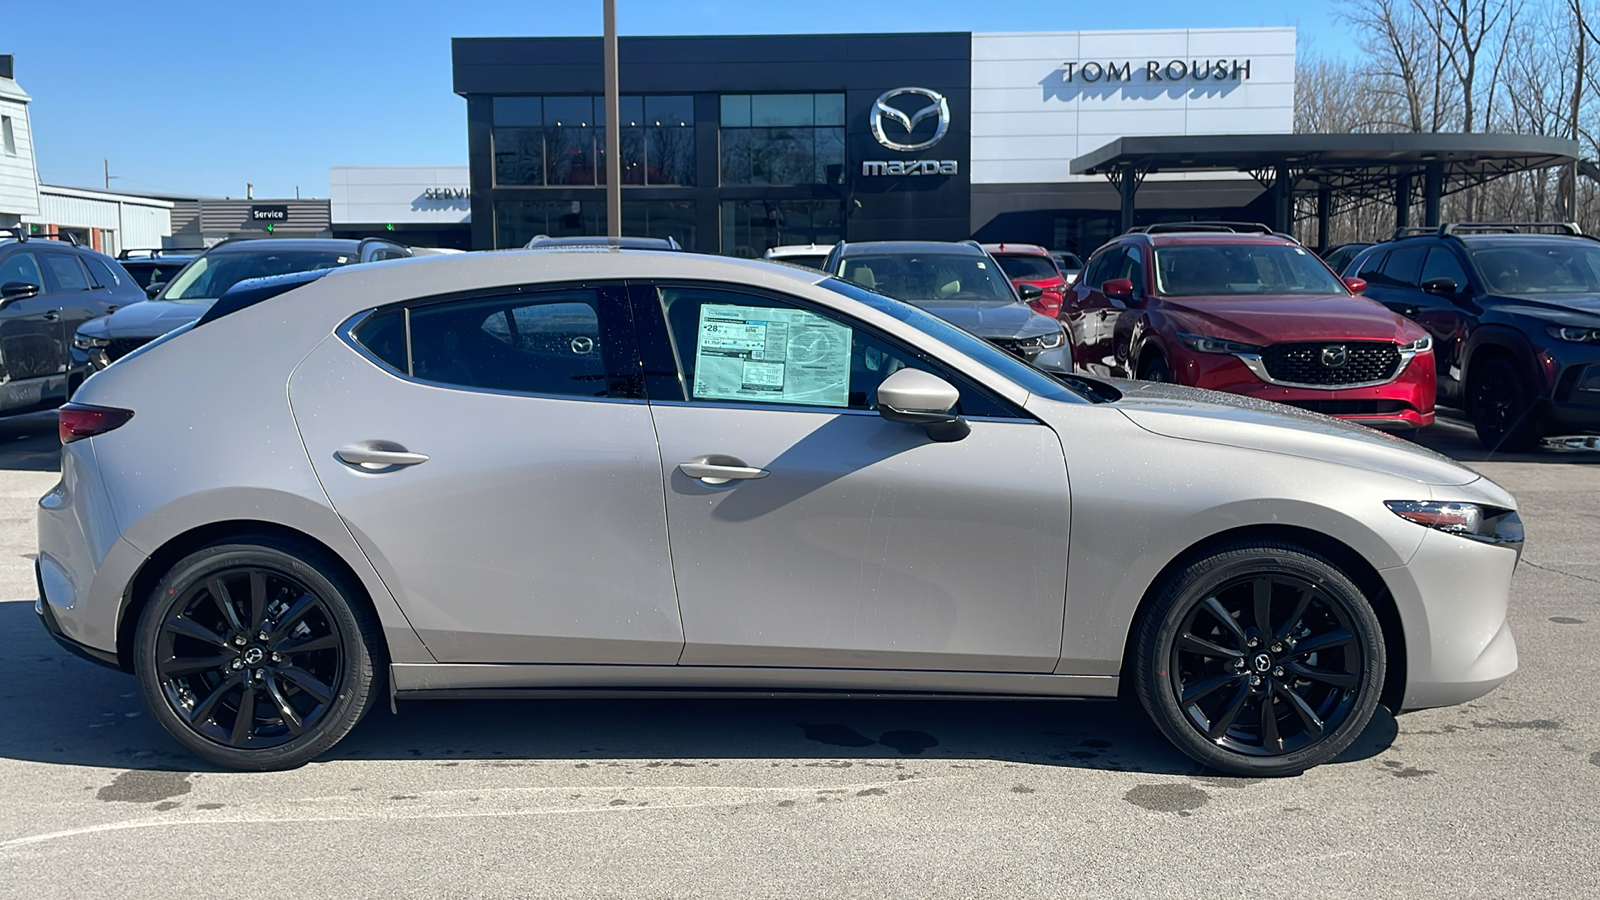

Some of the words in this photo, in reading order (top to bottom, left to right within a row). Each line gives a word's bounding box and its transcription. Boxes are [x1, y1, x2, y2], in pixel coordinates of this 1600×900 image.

[1063, 61, 1131, 83] TOM
[1146, 59, 1251, 82] ROUSH
[254, 210, 284, 219] Service
[707, 324, 718, 333] 28
